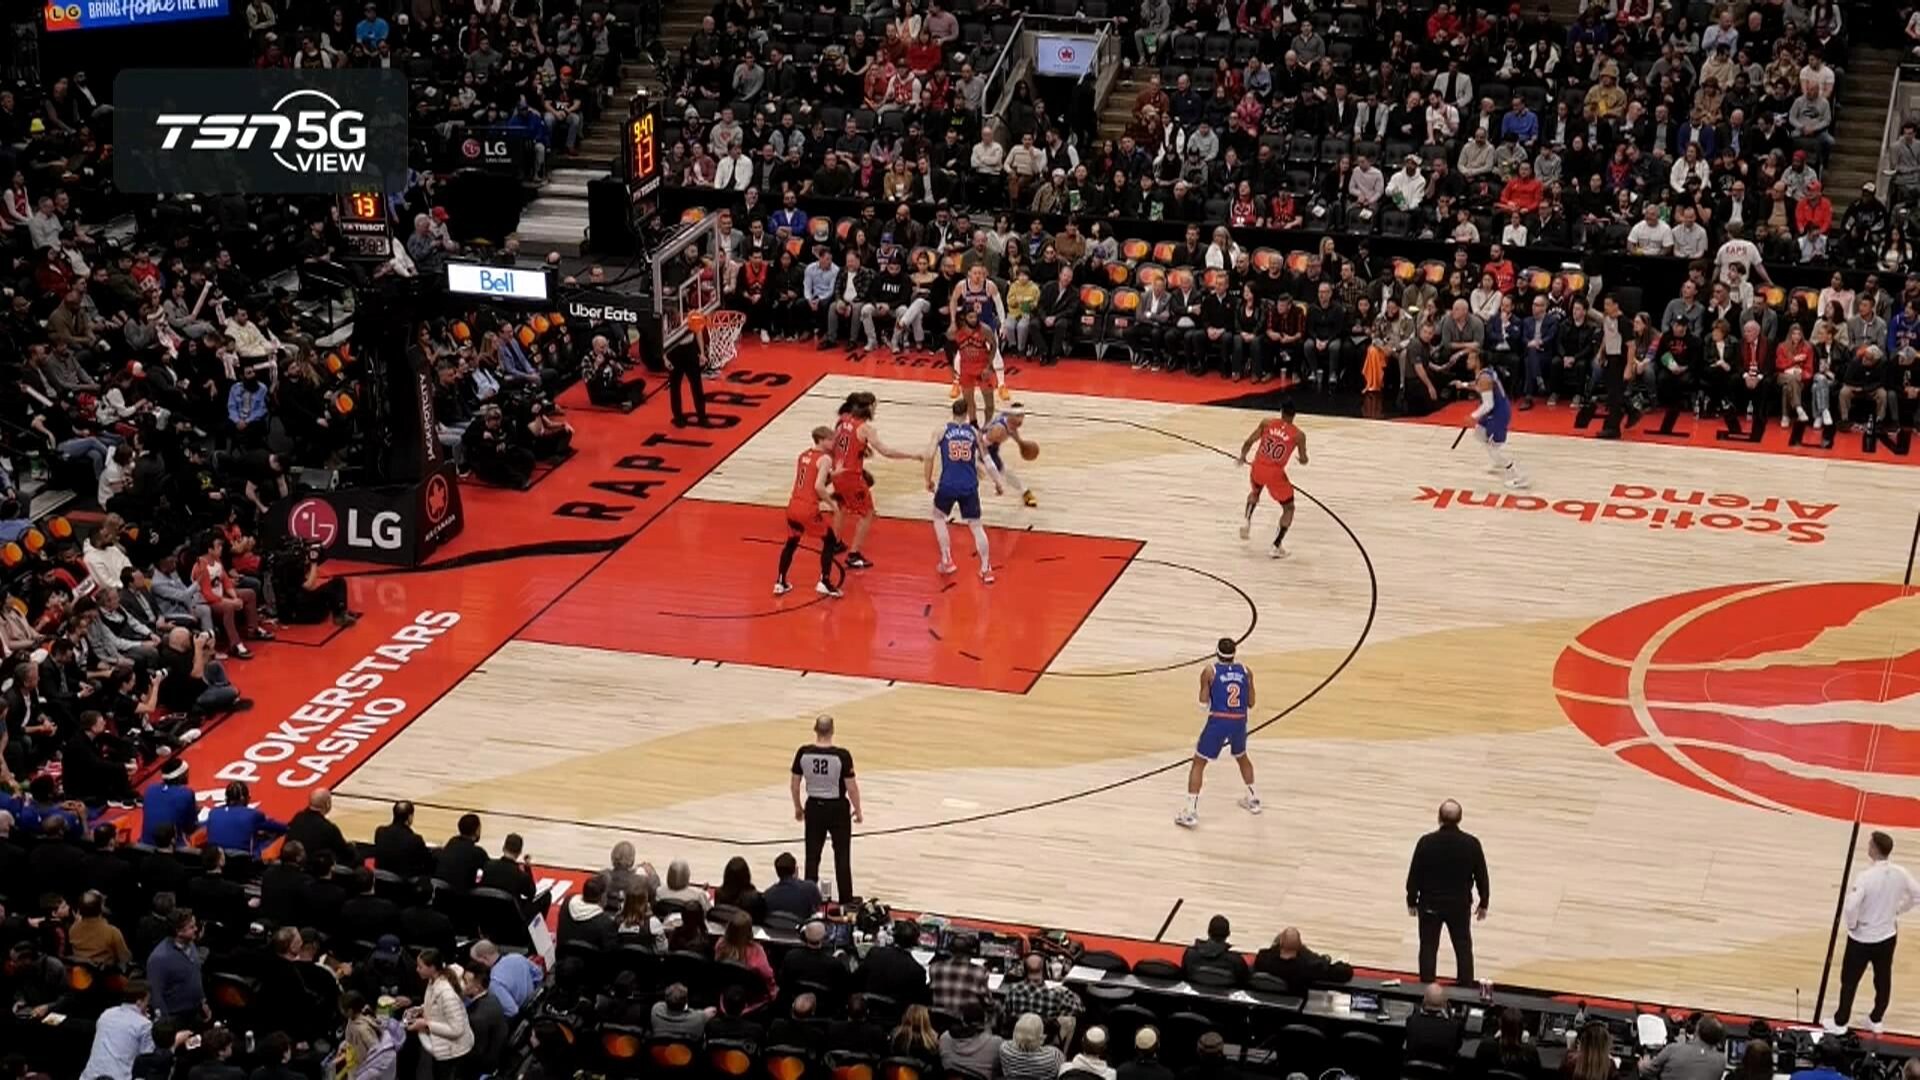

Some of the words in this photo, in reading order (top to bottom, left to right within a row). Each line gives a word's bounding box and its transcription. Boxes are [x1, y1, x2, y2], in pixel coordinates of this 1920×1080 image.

[88, 1, 121, 18] BRING
[484, 141, 507, 156] LG
[637, 136, 653, 178] 13
[357, 197, 375, 218] 13
[480, 270, 515, 293] Bell
[570, 303, 602, 319] Uber
[604, 306, 638, 323] Eats
[552, 370, 793, 521] RAPTORS
[948, 440, 972, 461] 55
[1610, 484, 1840, 520] Arena
[1411, 485, 1829, 544] Scotiabank
[347, 508, 402, 549] LG
[214, 610, 461, 782] POKERSTARS
[1227, 683, 1240, 707] 2
[277, 697, 407, 788] CASINO
[813, 758, 828, 775] 32
